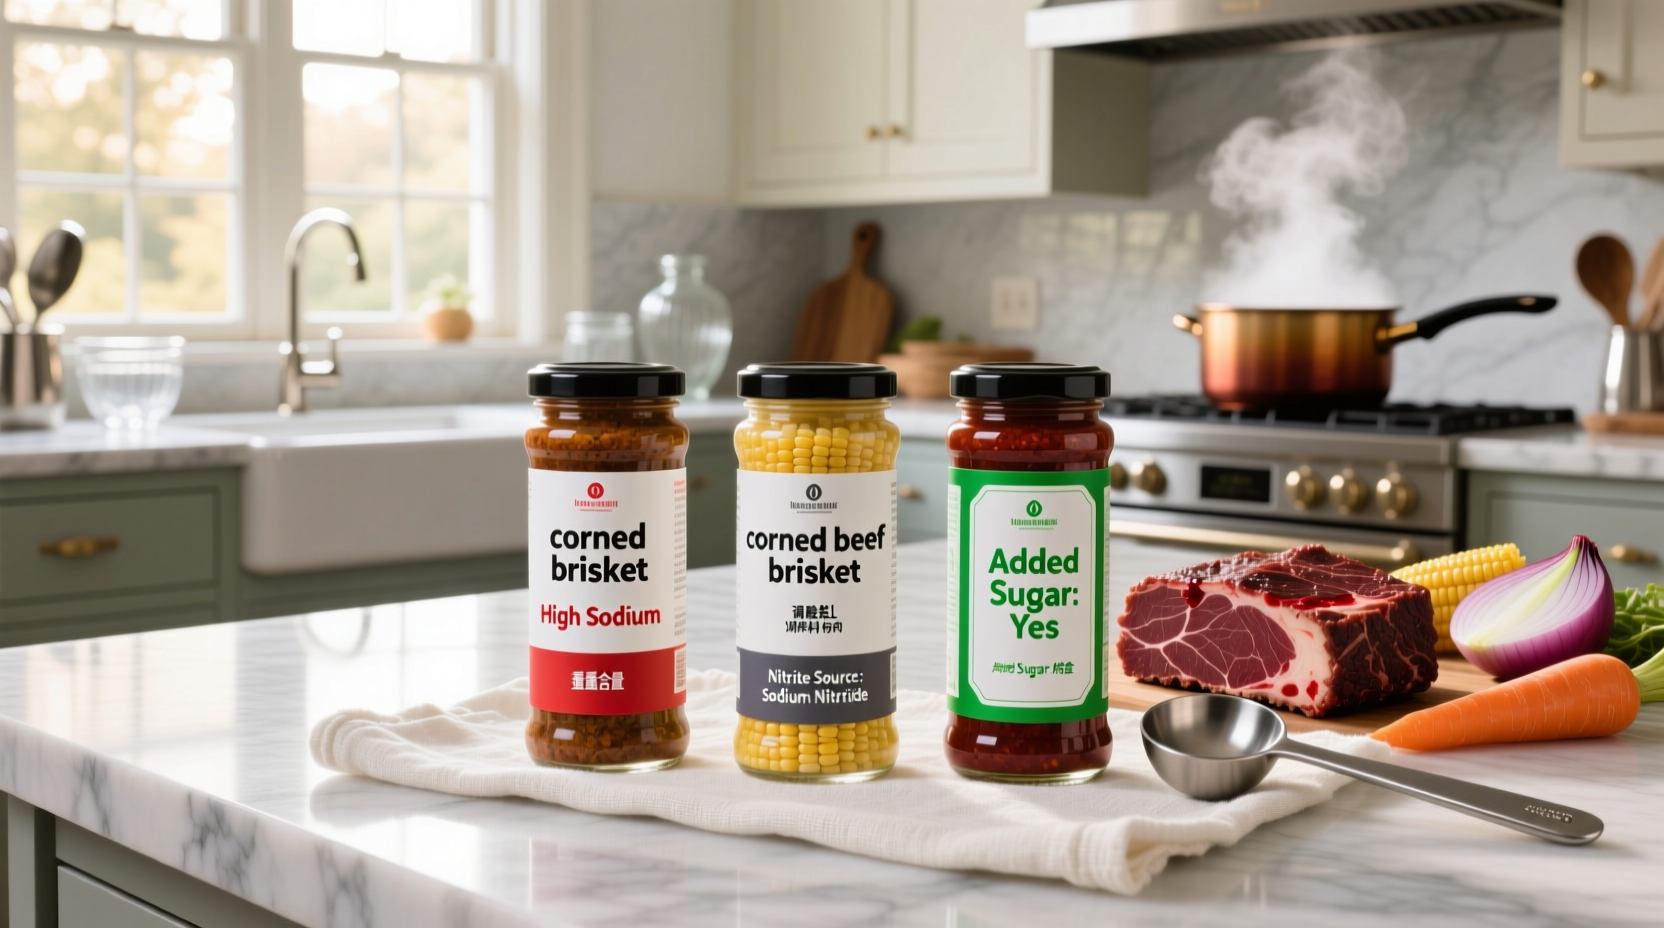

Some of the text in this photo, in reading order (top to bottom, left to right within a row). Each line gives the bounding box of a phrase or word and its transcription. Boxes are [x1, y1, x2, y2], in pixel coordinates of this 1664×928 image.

[550, 522, 646, 550] corned
[747, 524, 886, 551] corned beef
[551, 554, 648, 582] brisket
[769, 557, 861, 584] brisket
[988, 547, 1079, 574] Added
[990, 579, 1079, 613] Sugar:
[541, 604, 581, 631] High
[586, 605, 661, 627] Sodium
[1010, 613, 1059, 639] Yes
[769, 669, 863, 684] Nitrite Source:
[1017, 662, 1050, 678] Sugar
[762, 688, 810, 704] Sodium
